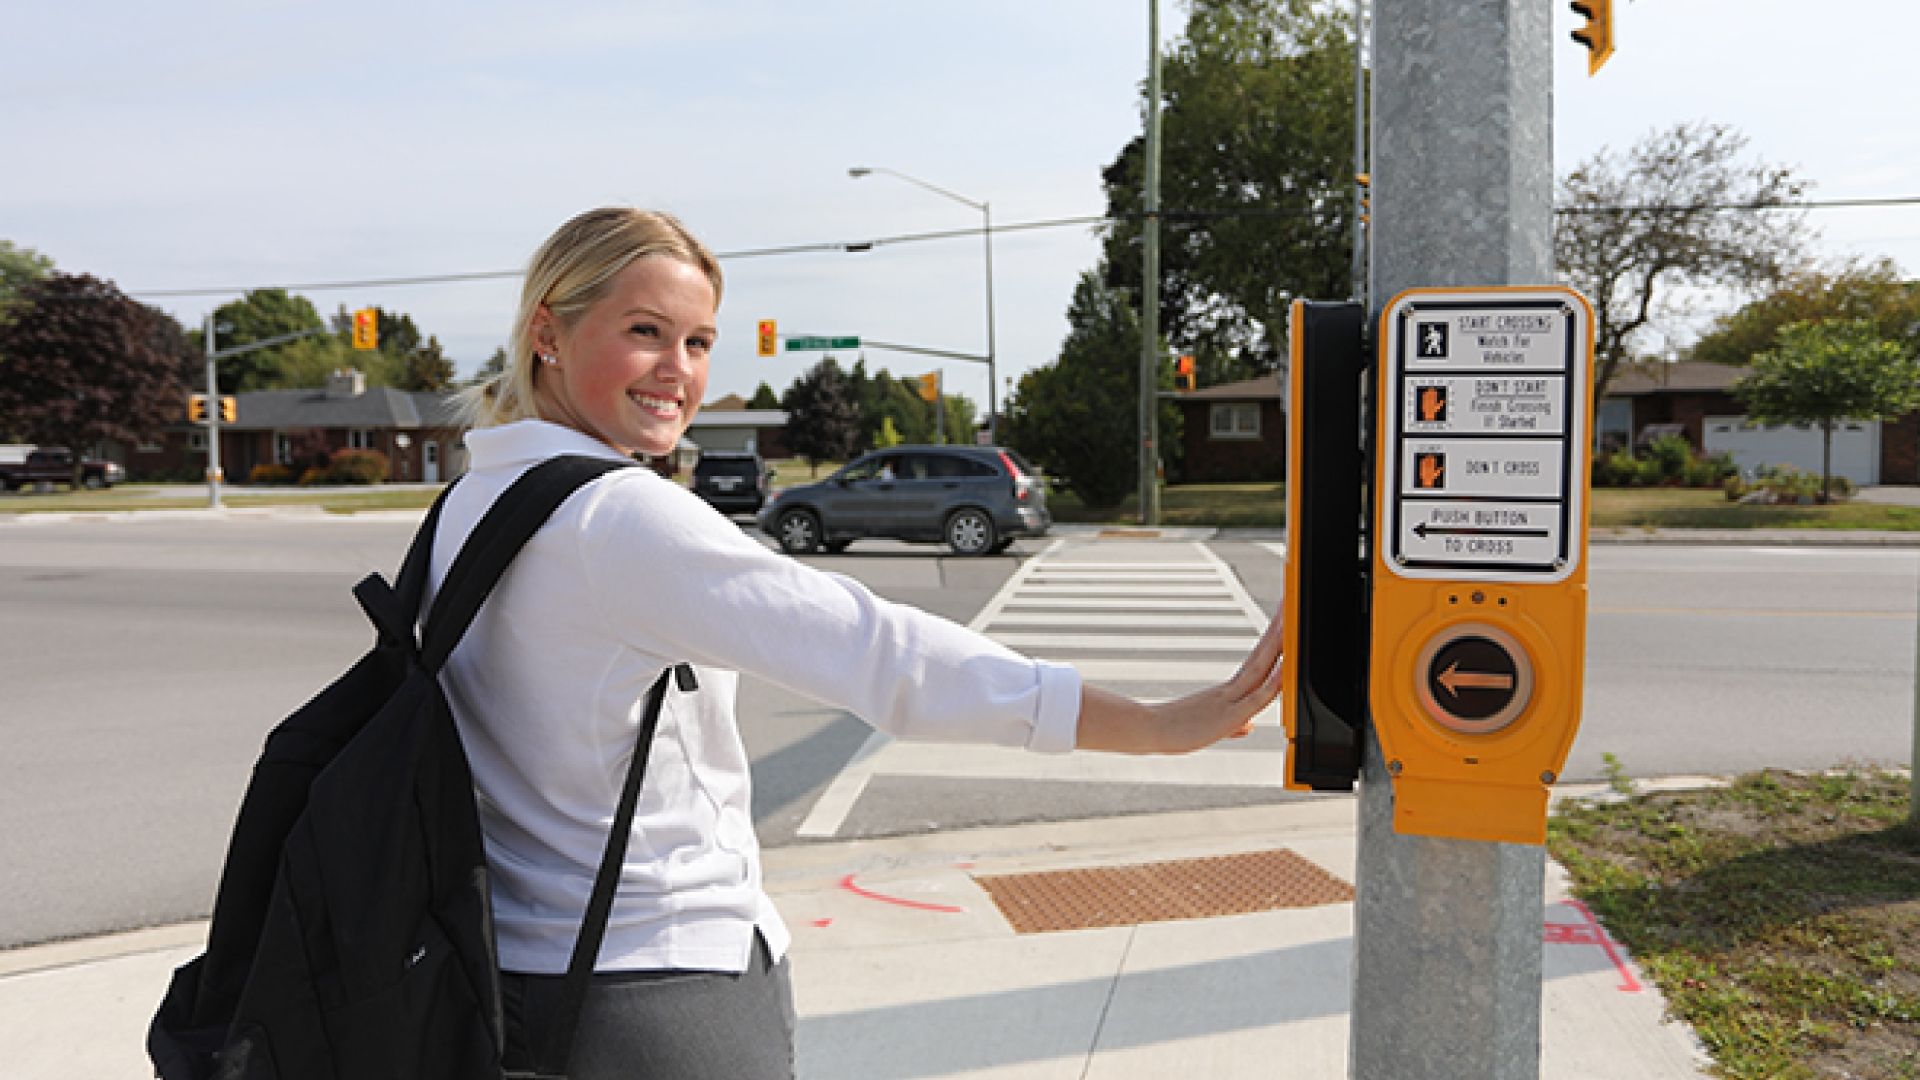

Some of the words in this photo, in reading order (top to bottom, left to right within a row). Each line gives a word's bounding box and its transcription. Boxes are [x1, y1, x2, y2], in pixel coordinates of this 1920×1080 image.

[1458, 315, 1490, 329] START
[1497, 315, 1552, 329] CROSSING
[1475, 379, 1509, 392] DON'T
[1514, 379, 1548, 392] START
[1504, 461, 1540, 475] CROSS
[1431, 508, 1470, 523] PUSH
[1475, 510, 1528, 525] BUTTON
[1445, 539, 1463, 552] TO
[1468, 539, 1514, 554] CROSS
